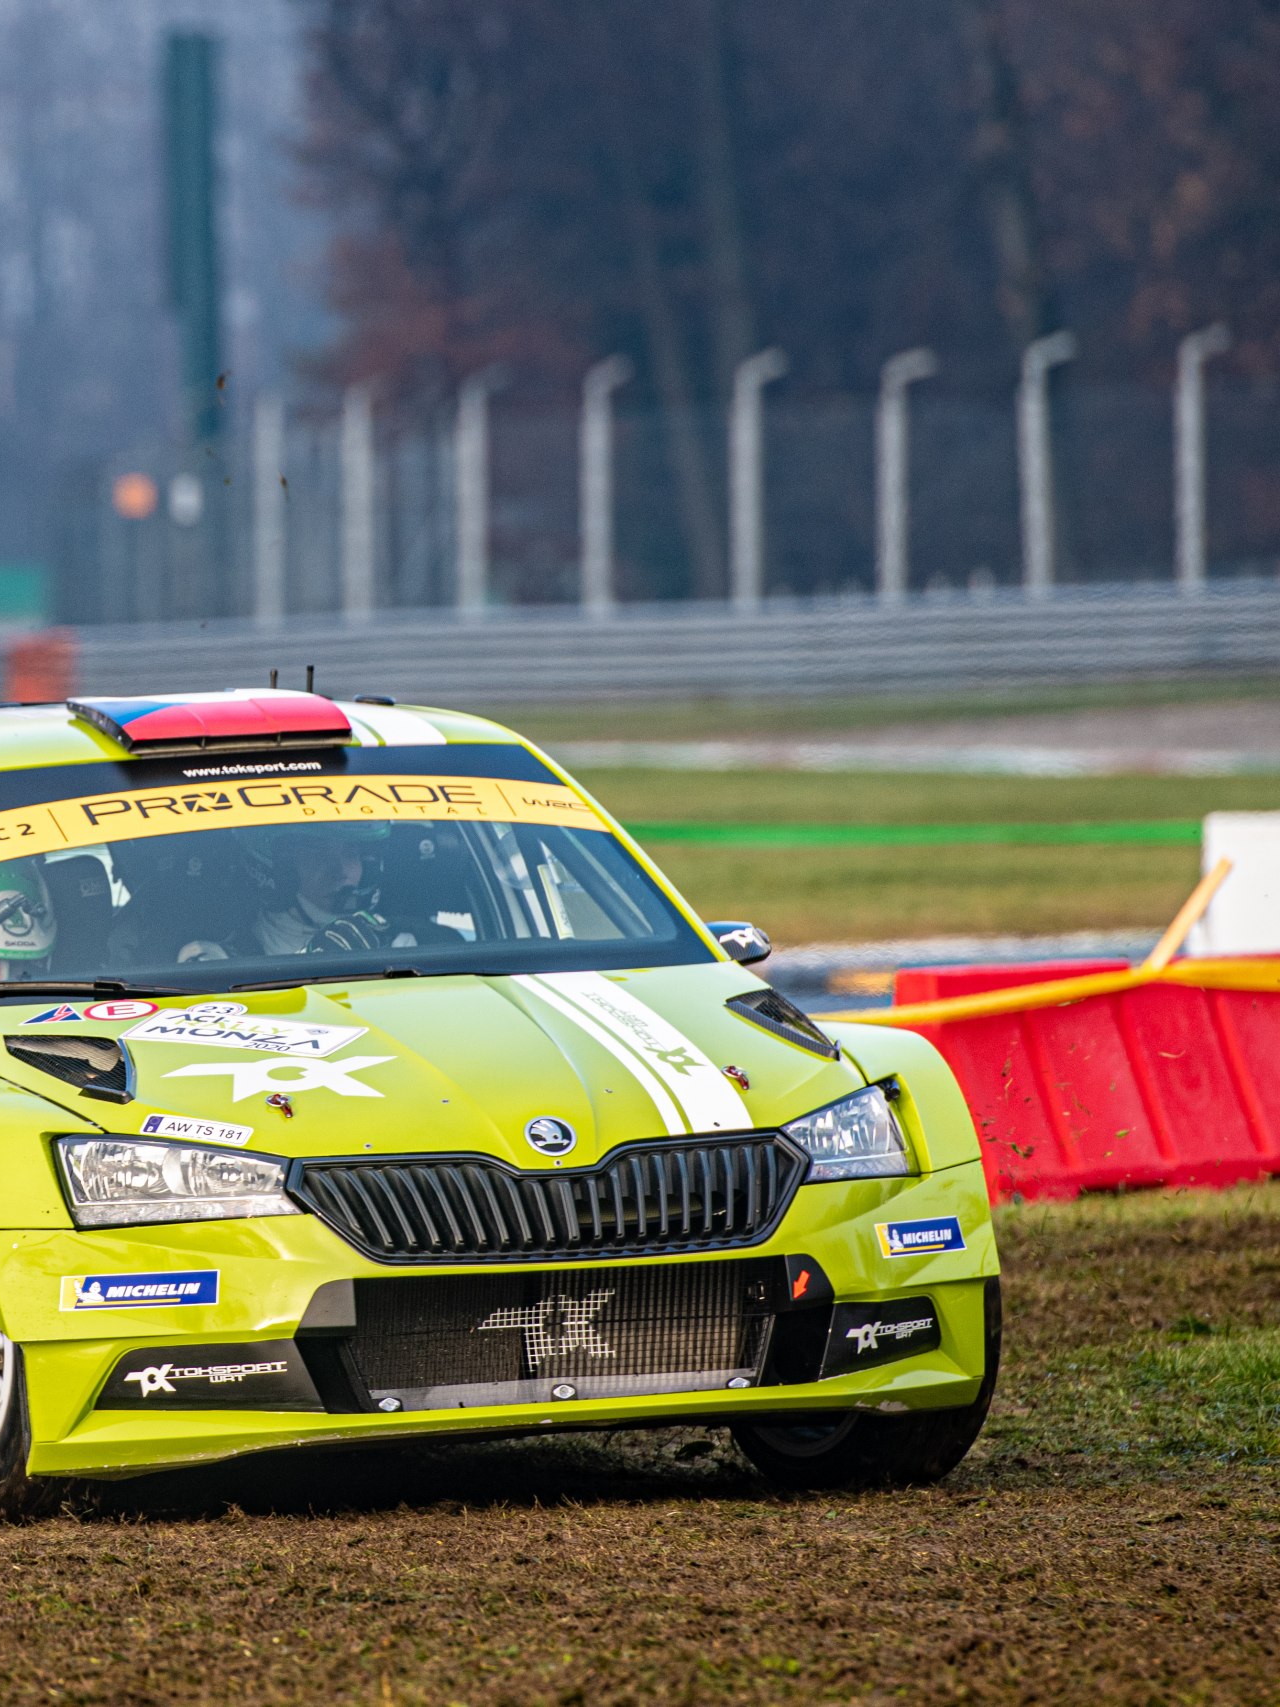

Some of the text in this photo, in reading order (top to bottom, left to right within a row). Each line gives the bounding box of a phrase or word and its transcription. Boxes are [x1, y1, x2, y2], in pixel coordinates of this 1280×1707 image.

[183, 761, 322, 778] www.toksport.com
[303, 805, 488, 816] DIGITAL
[16, 823, 35, 837] 2
[106, 1003, 137, 1016] E
[199, 1005, 235, 1015] 23
[144, 1025, 321, 1050] MONZA
[243, 1042, 292, 1052] 2020
[165, 1121, 243, 1141] AW TS 181
[902, 1228, 953, 1245] MICHELIN
[105, 1281, 202, 1299] MICHELIN
[171, 1360, 288, 1376] TOKSPORT
[208, 1373, 247, 1384] WRT
